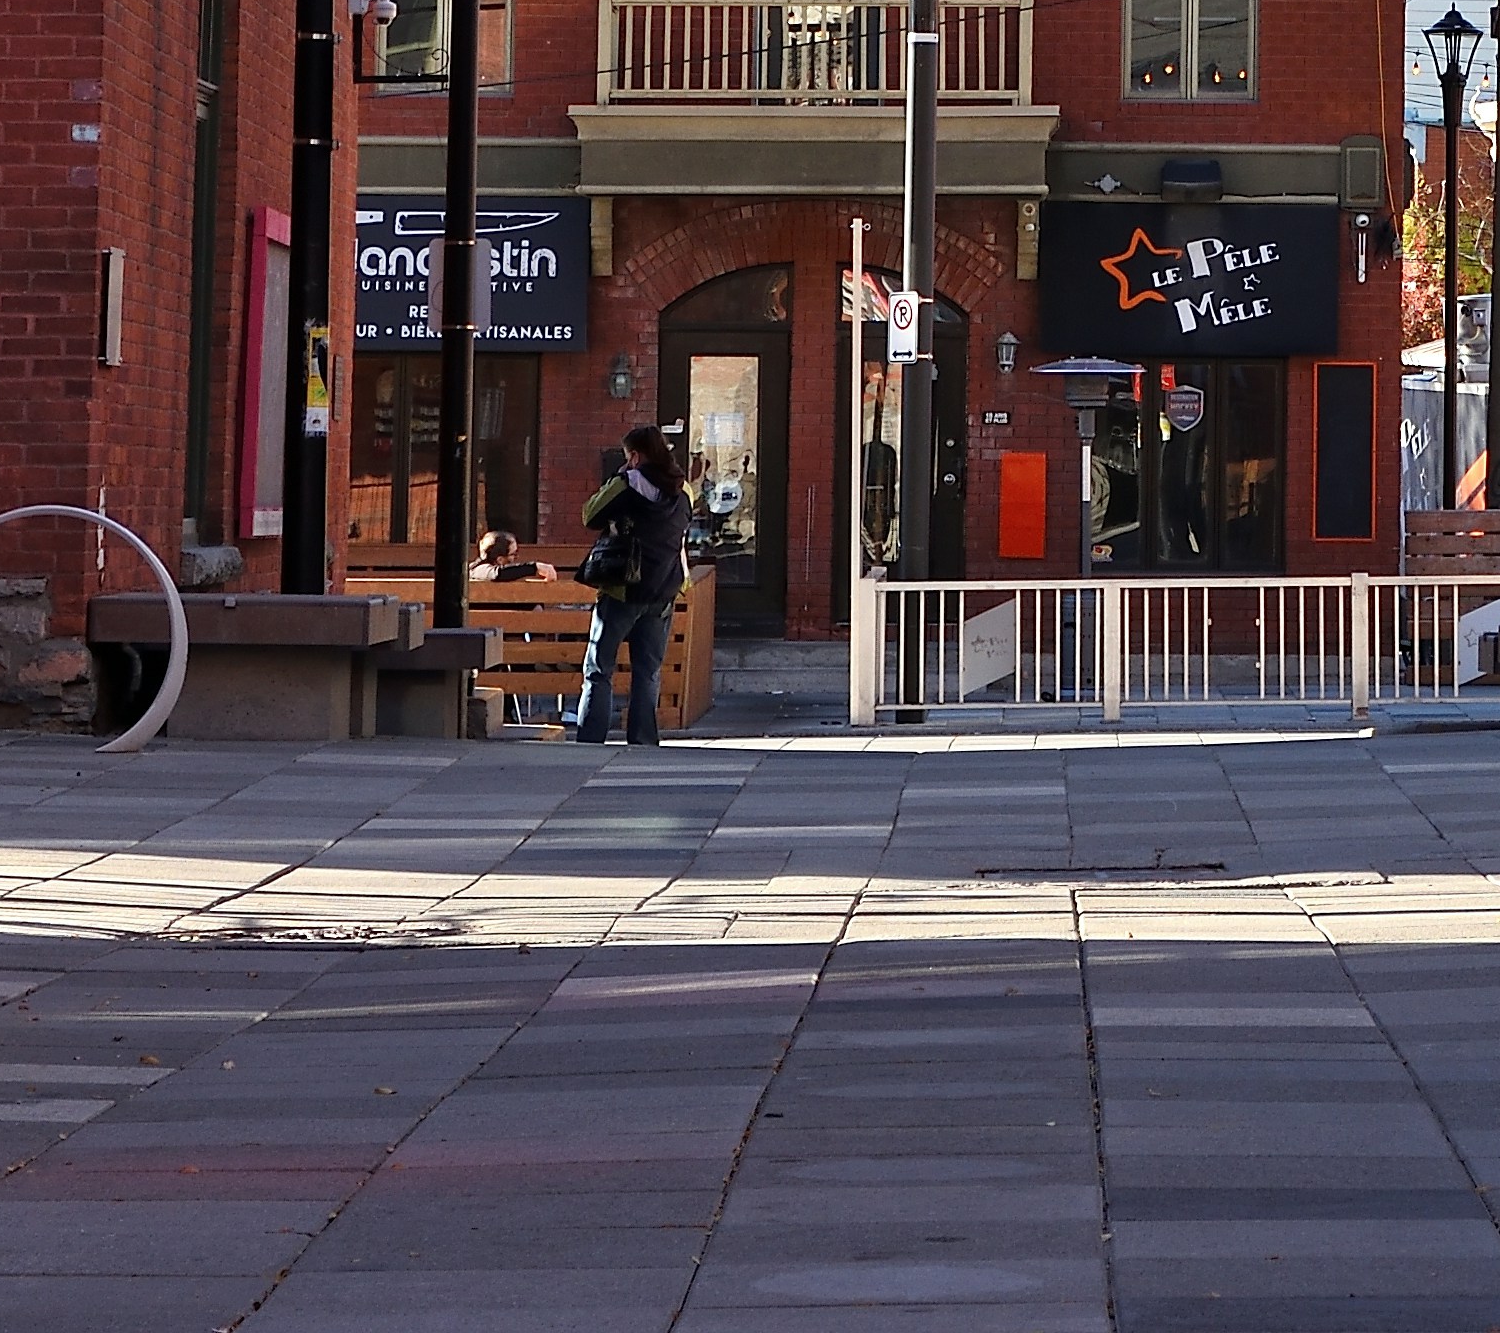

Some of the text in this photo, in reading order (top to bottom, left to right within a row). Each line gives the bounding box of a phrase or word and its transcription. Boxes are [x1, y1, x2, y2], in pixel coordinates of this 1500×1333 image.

[354, 238, 557, 277] anstin
[361, 280, 426, 291] UISINE
[1151, 267, 1183, 288] LE
[473, 325, 572, 339] TISANALES
